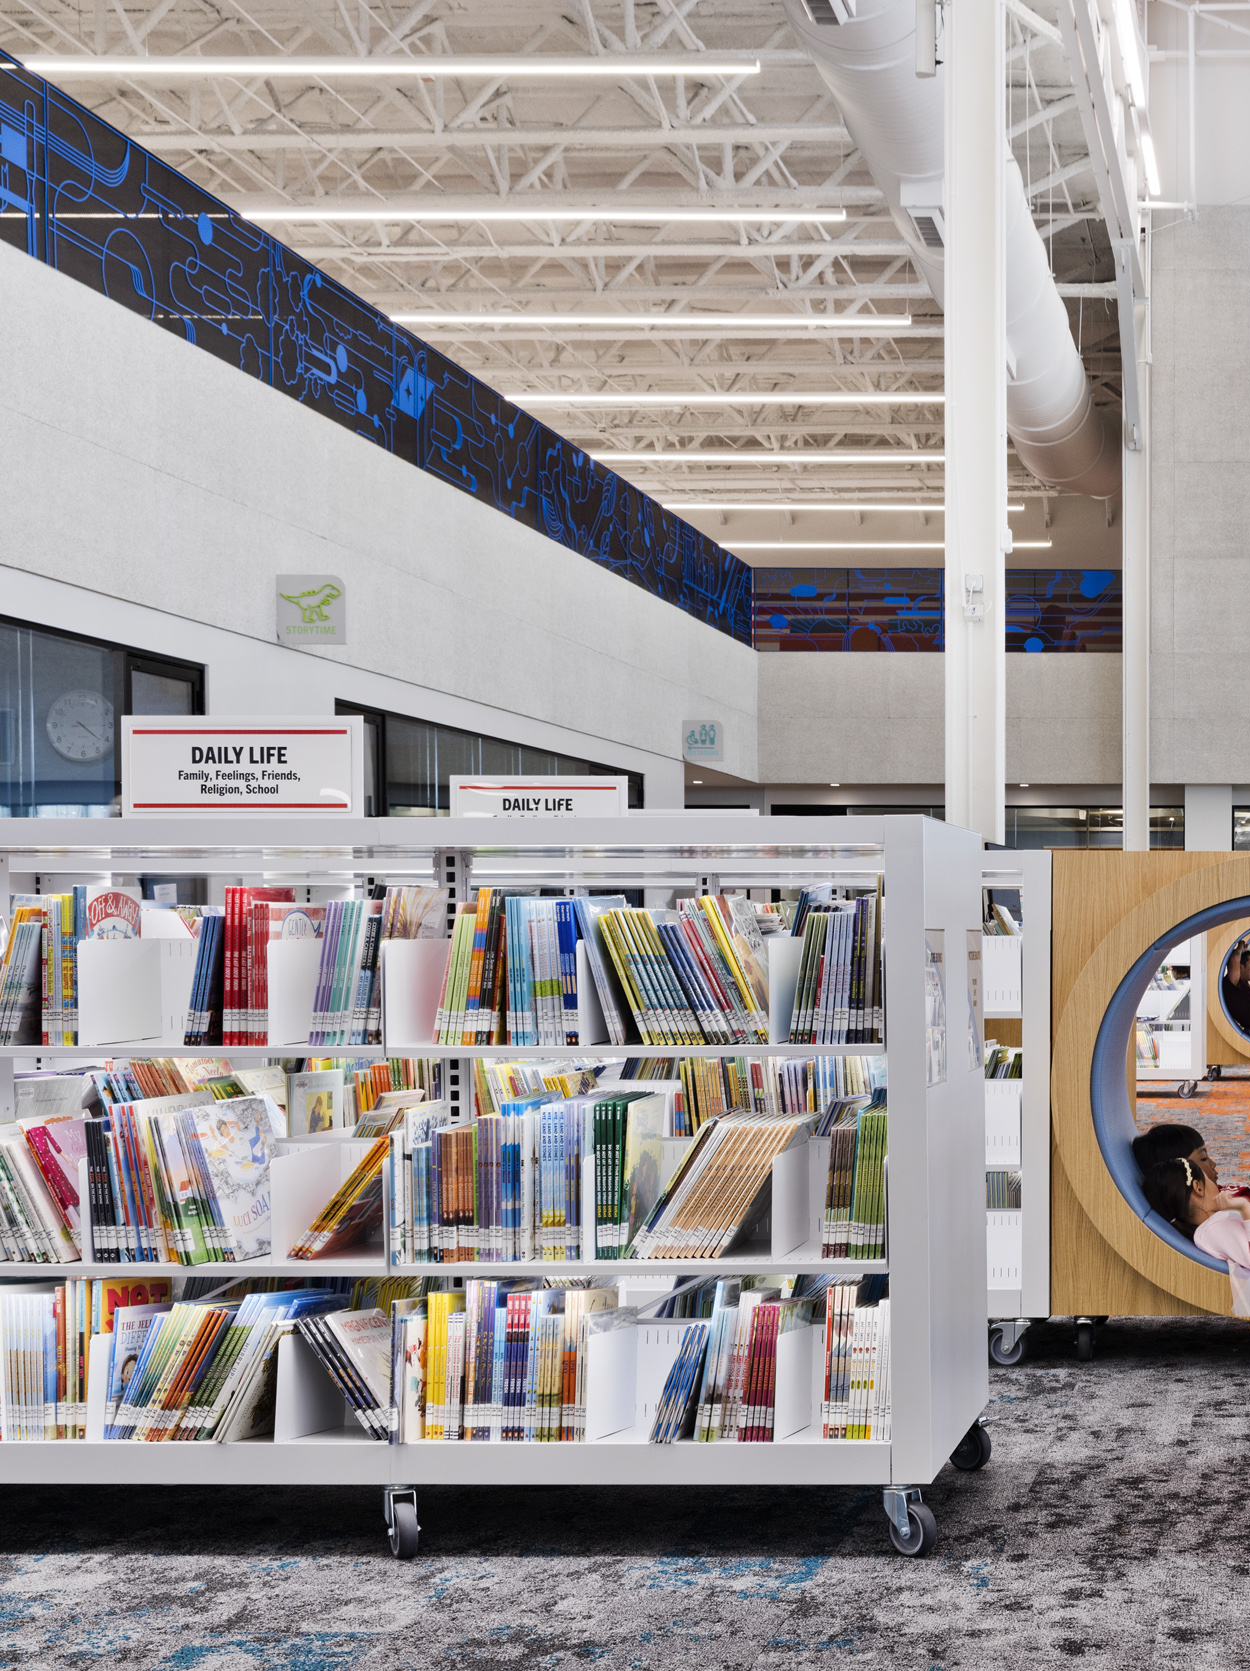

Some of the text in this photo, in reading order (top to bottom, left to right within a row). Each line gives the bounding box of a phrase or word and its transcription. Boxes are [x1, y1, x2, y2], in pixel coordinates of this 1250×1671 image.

[286, 626, 336, 634] STORYTIME
[81, 750, 86, 758] 6
[192, 746, 288, 764] DAILY LIFE
[178, 770, 301, 782] Family, Feelings, Friends,
[201, 784, 280, 796] Religion, School
[502, 798, 573, 811] DAILY LIFE
[233, 1190, 271, 1228] LUCI SOA
[107, 1283, 168, 1314] NOT
[121, 1320, 136, 1332] THE
[236, 1342, 250, 1366] HURRY
